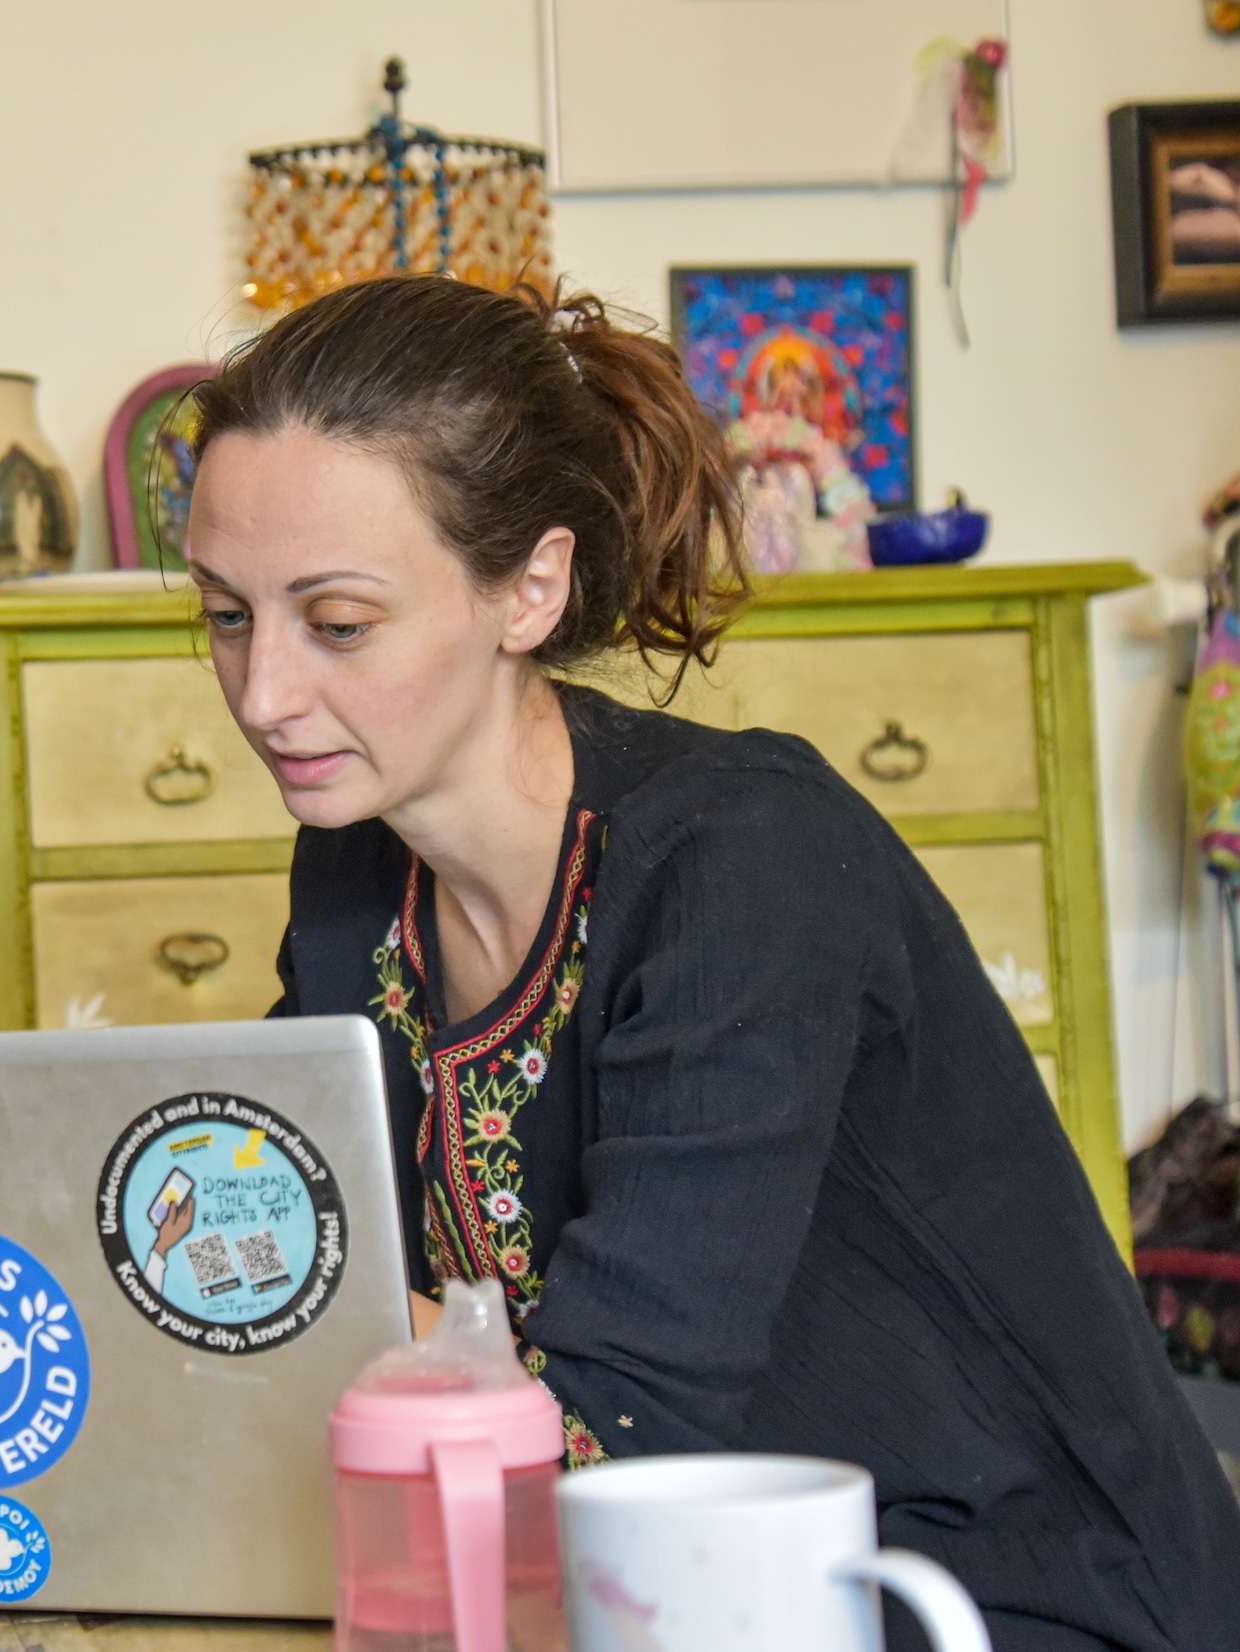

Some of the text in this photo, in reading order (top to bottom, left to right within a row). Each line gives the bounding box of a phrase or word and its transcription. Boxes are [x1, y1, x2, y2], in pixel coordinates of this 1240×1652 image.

[102, 1096, 327, 1235] Undocumented and in Amsterdam?
[202, 1174, 291, 1195] DOWNLOAD
[214, 1189, 302, 1208] THE CITY
[202, 1206, 292, 1227] RIGHTS APP
[116, 1260, 159, 1313] Know
[156, 1308, 201, 1341] your
[204, 1329, 245, 1351] city,
[246, 1314, 297, 1345] know
[296, 1278, 327, 1323] your
[318, 1211, 343, 1277] rights!
